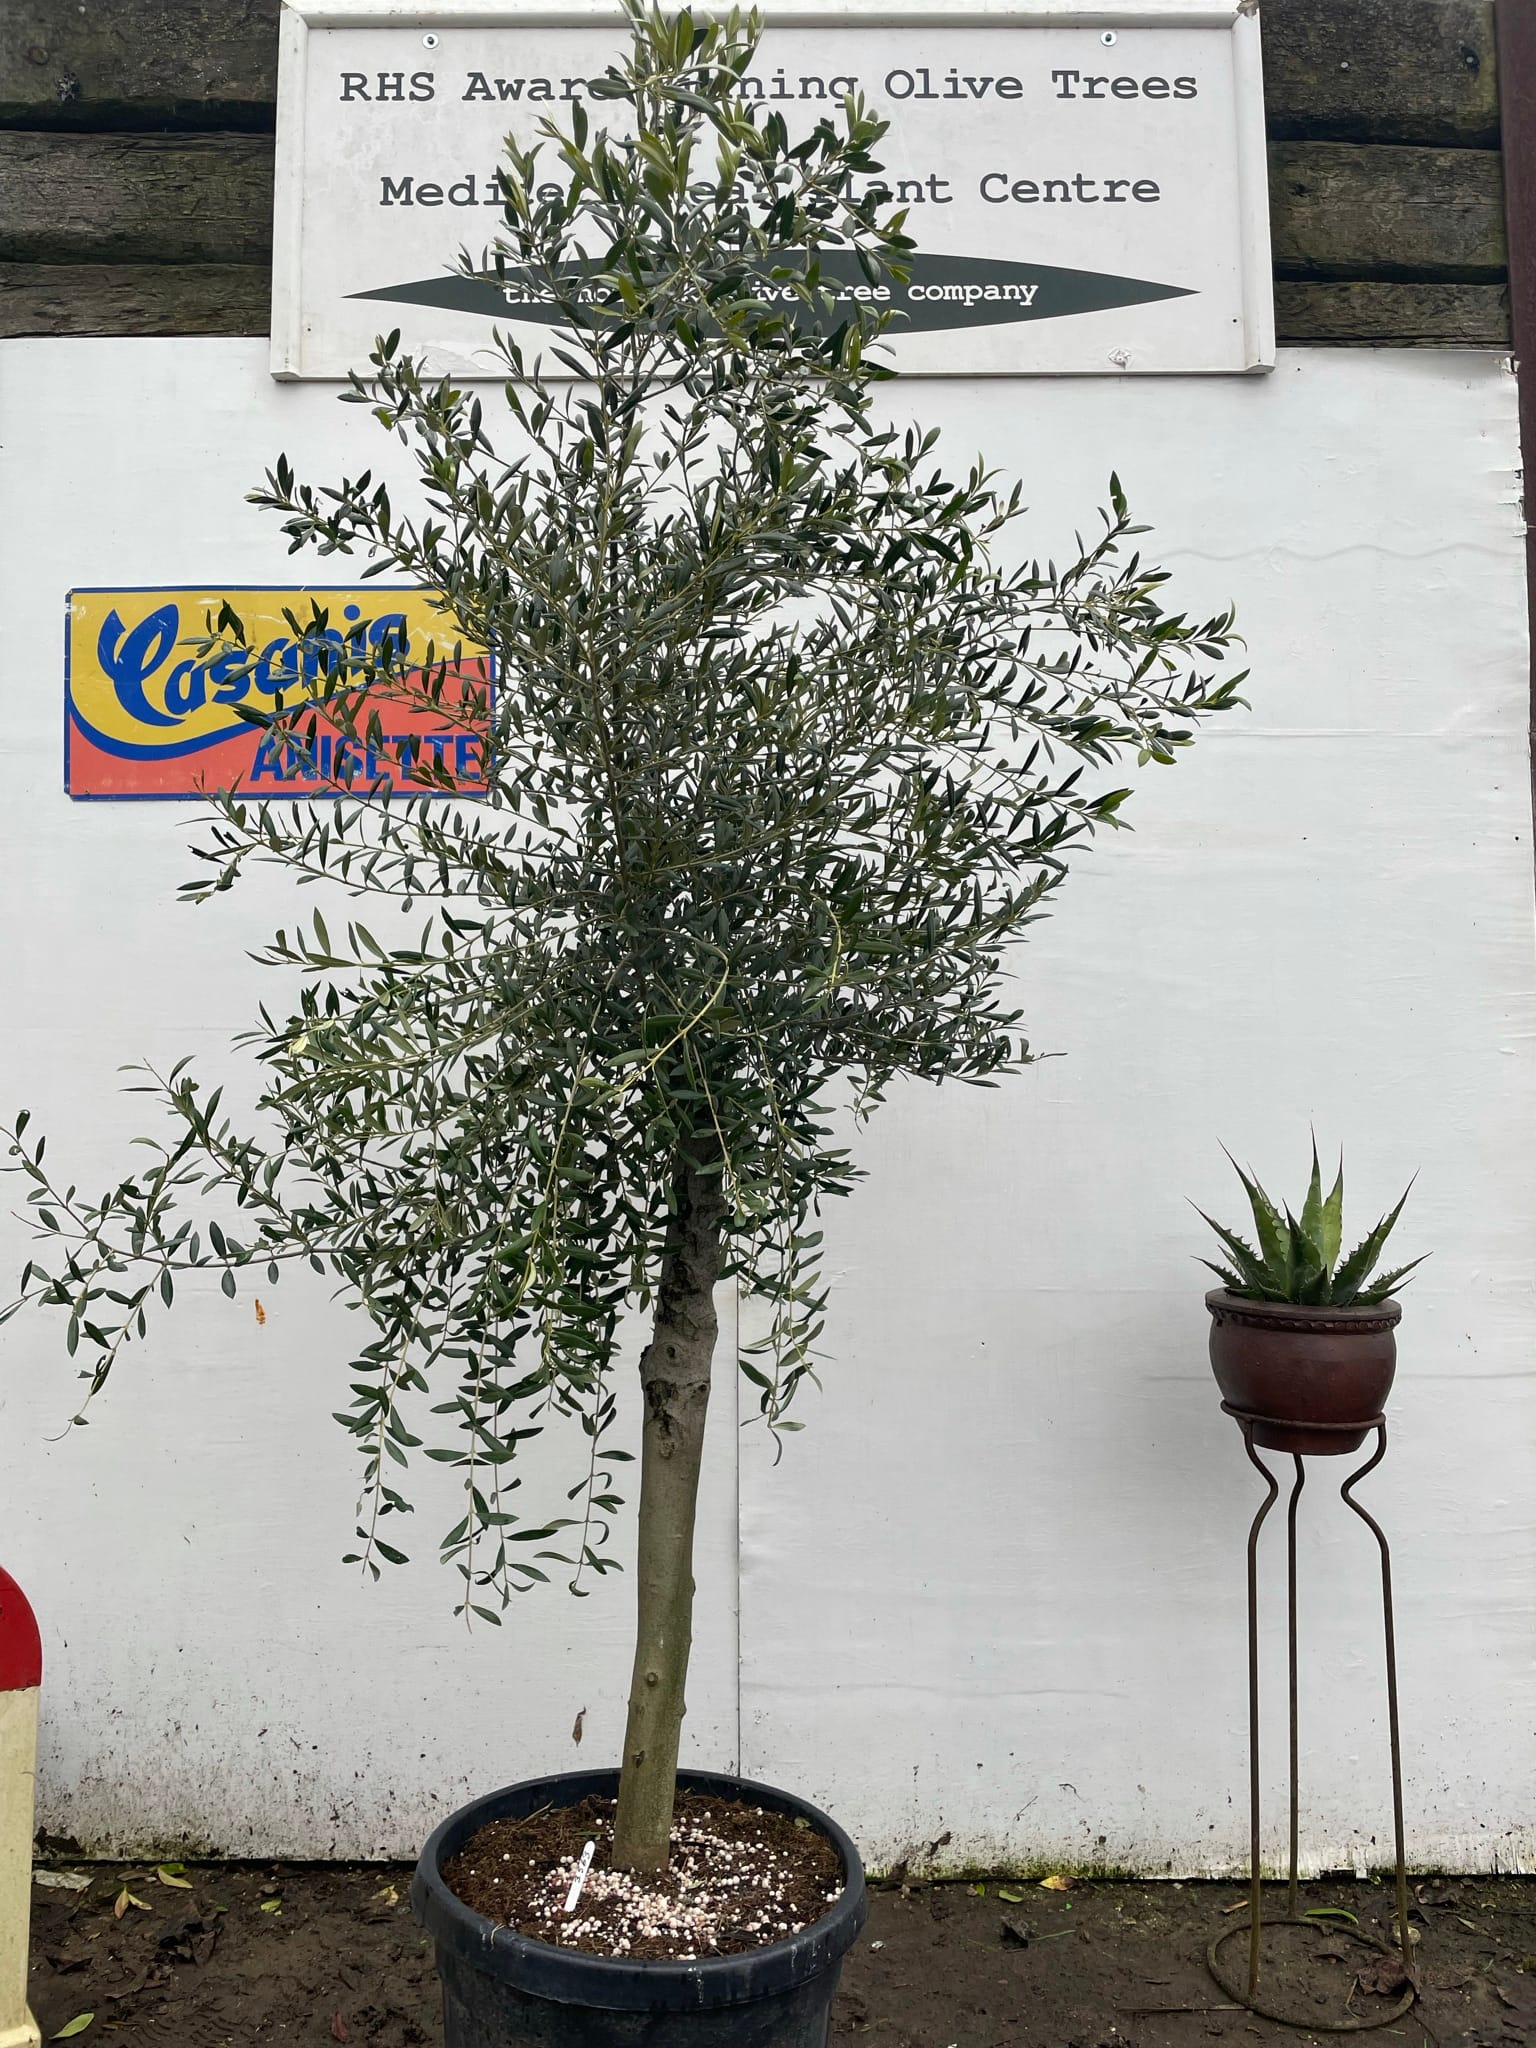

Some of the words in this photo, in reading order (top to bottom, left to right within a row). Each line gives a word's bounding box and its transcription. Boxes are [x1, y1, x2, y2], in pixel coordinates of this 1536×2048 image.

[340, 72, 435, 101] RHS
[884, 67, 1024, 100] Olive
[1051, 69, 1198, 100] Trees
[979, 172, 1161, 203] Centre
[907, 284, 1040, 307] company
[97, 603, 411, 727] Casanis
